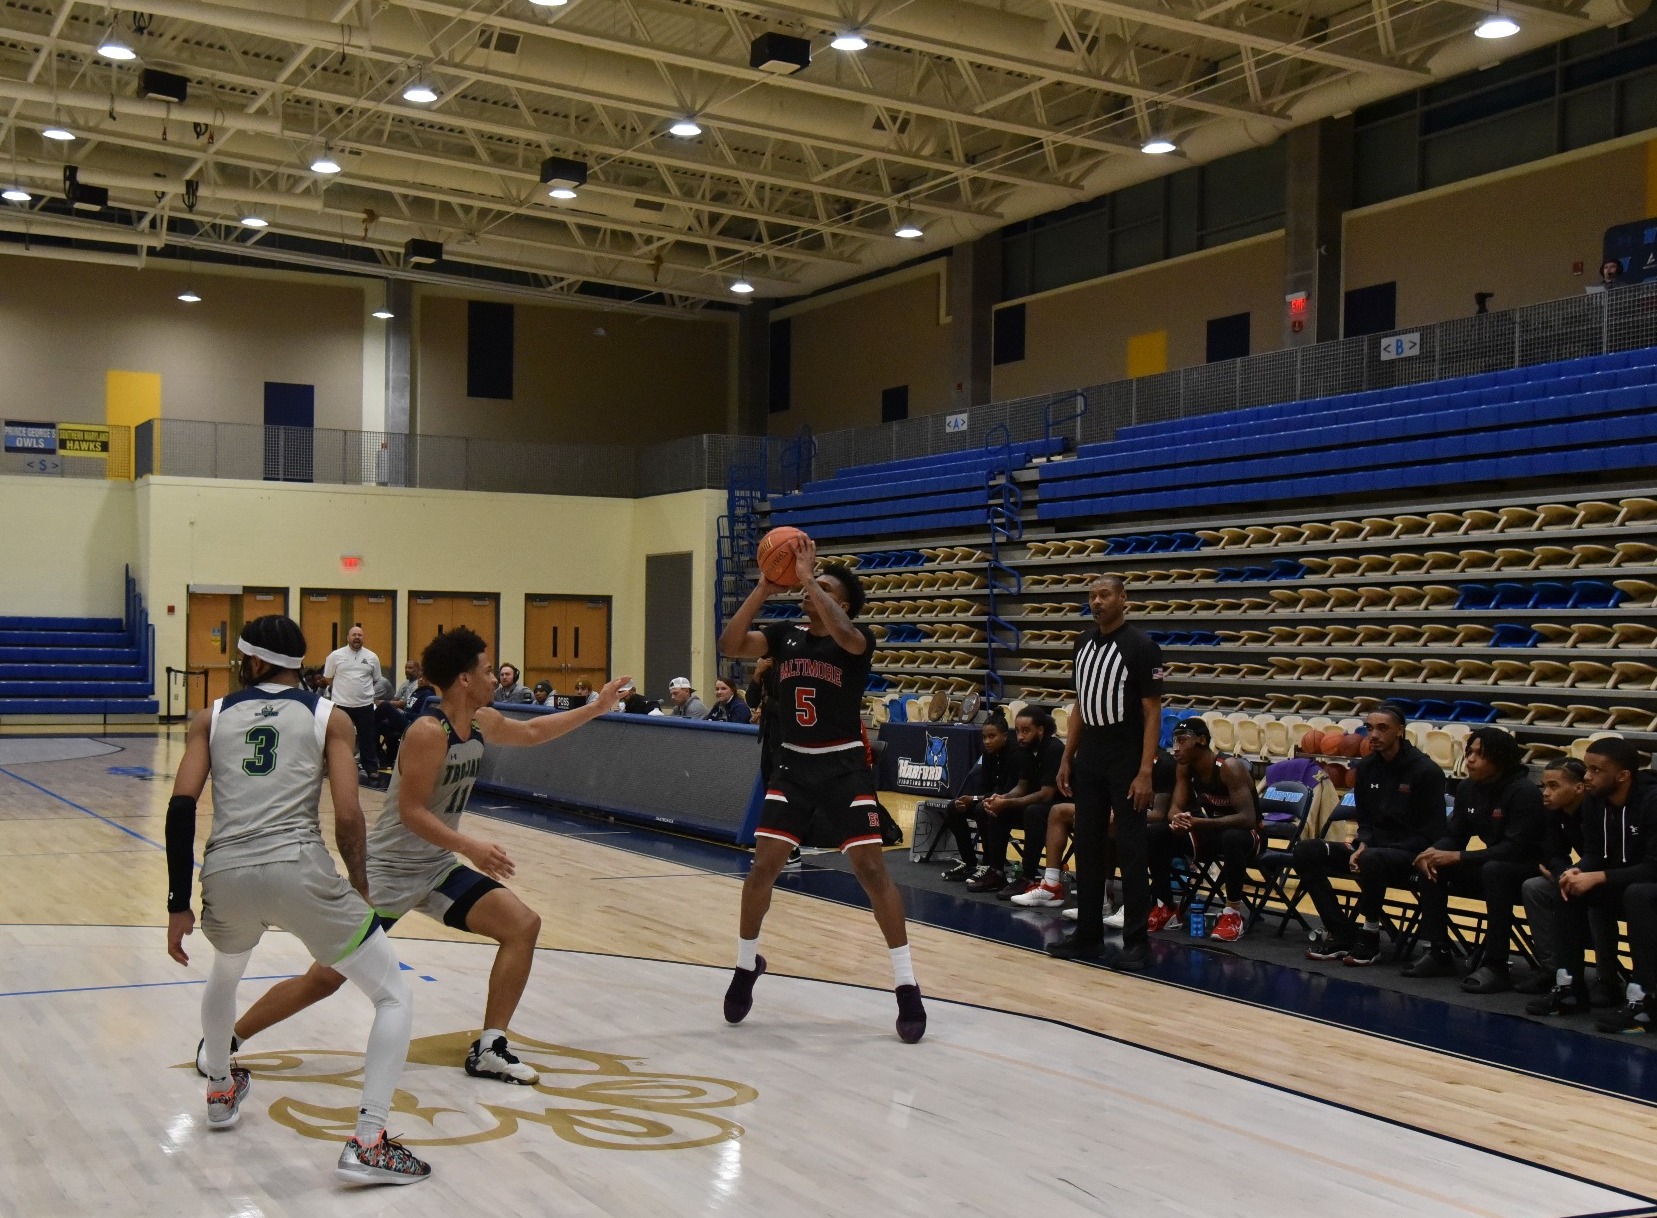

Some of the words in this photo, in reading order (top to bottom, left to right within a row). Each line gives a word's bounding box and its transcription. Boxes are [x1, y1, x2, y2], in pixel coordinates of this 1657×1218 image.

[1291, 299, 1305, 312] EXIT
[1395, 338, 1404, 356] B
[952, 417, 960, 430] A
[5, 426, 26, 437] PRINCE
[27, 427, 56, 439] GEORGE'S
[16, 438, 45, 449] OWLS
[66, 440, 102, 452] HAWKS
[38, 459, 47, 471] S
[795, 687, 818, 727] 5
[242, 725, 280, 777] 3
[898, 759, 943, 781] HARFORD
[444, 784, 470, 814] 11
